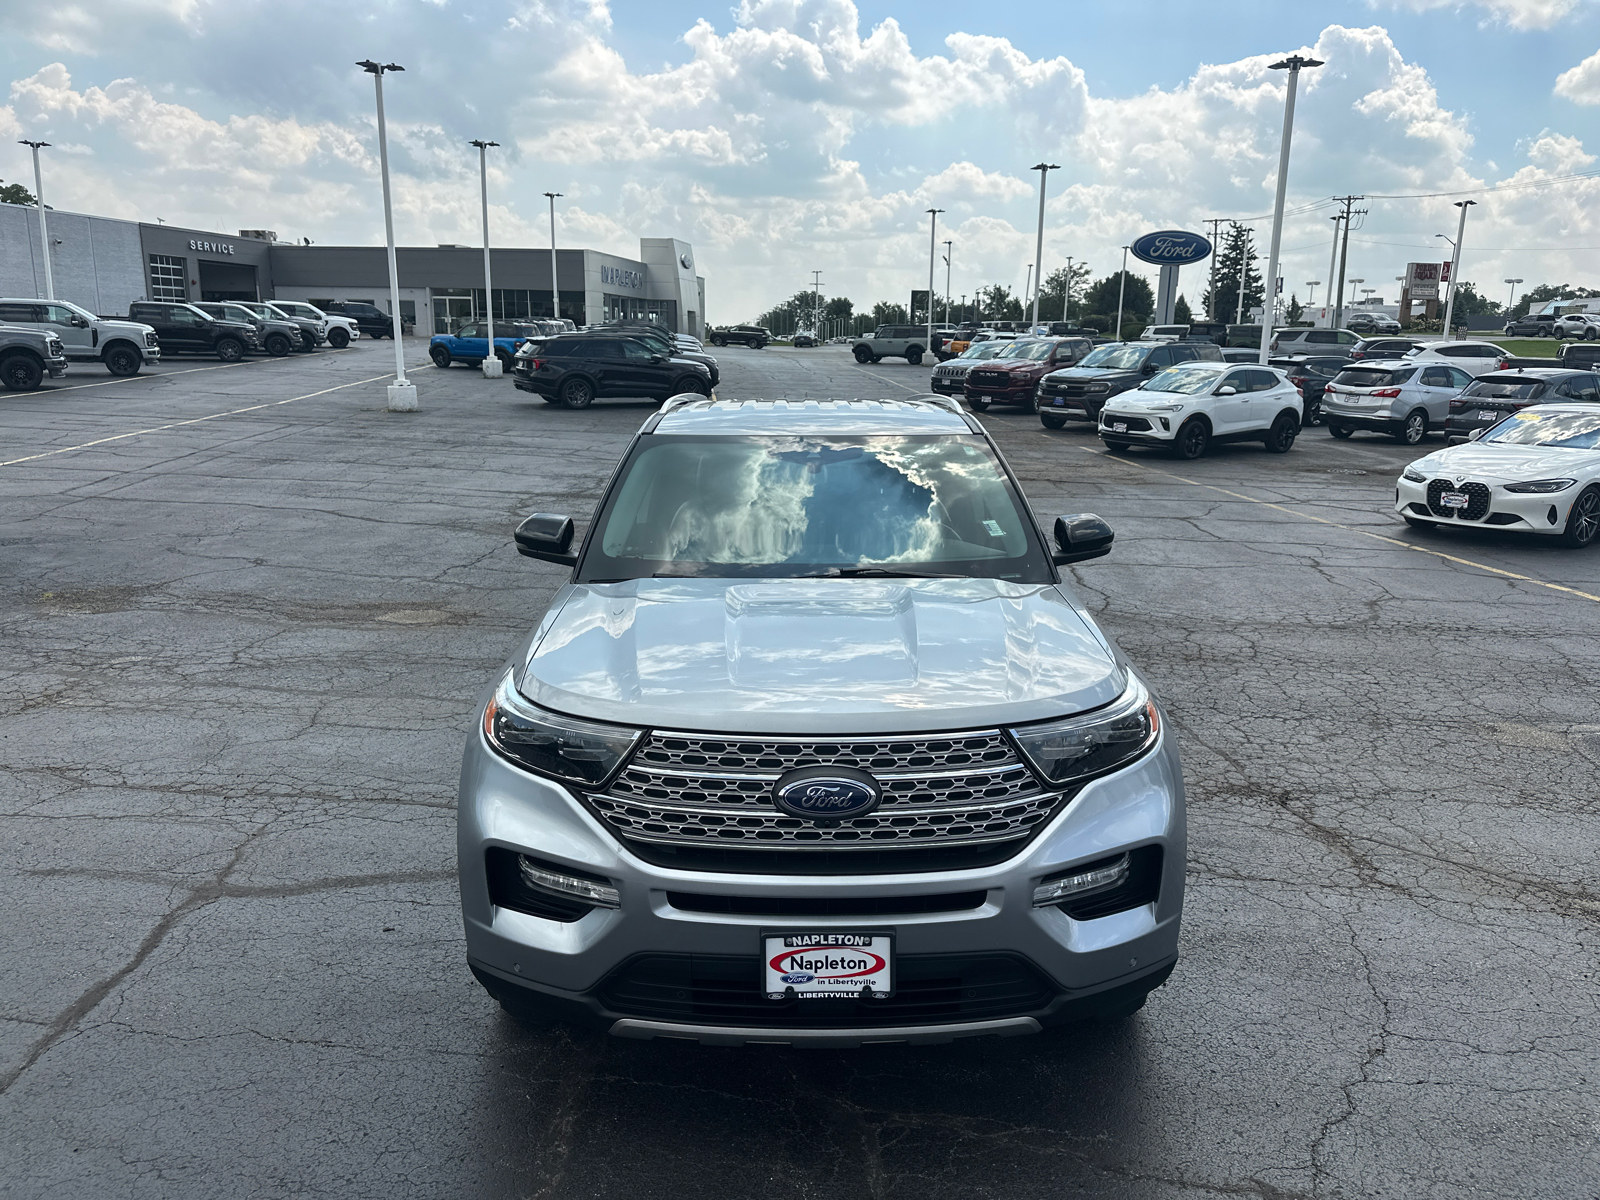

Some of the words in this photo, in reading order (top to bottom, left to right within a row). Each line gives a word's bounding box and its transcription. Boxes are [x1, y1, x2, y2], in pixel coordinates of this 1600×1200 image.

[190, 240, 235, 255] SERVICE
[1150, 236, 1197, 257] Ford
[601, 264, 643, 290] NAPLETON
[801, 786, 853, 808] Ford
[792, 935, 864, 946] NAPLETON
[790, 955, 867, 973] Napleton
[787, 974, 808, 983] Ford
[828, 978, 876, 986] Libertyville
